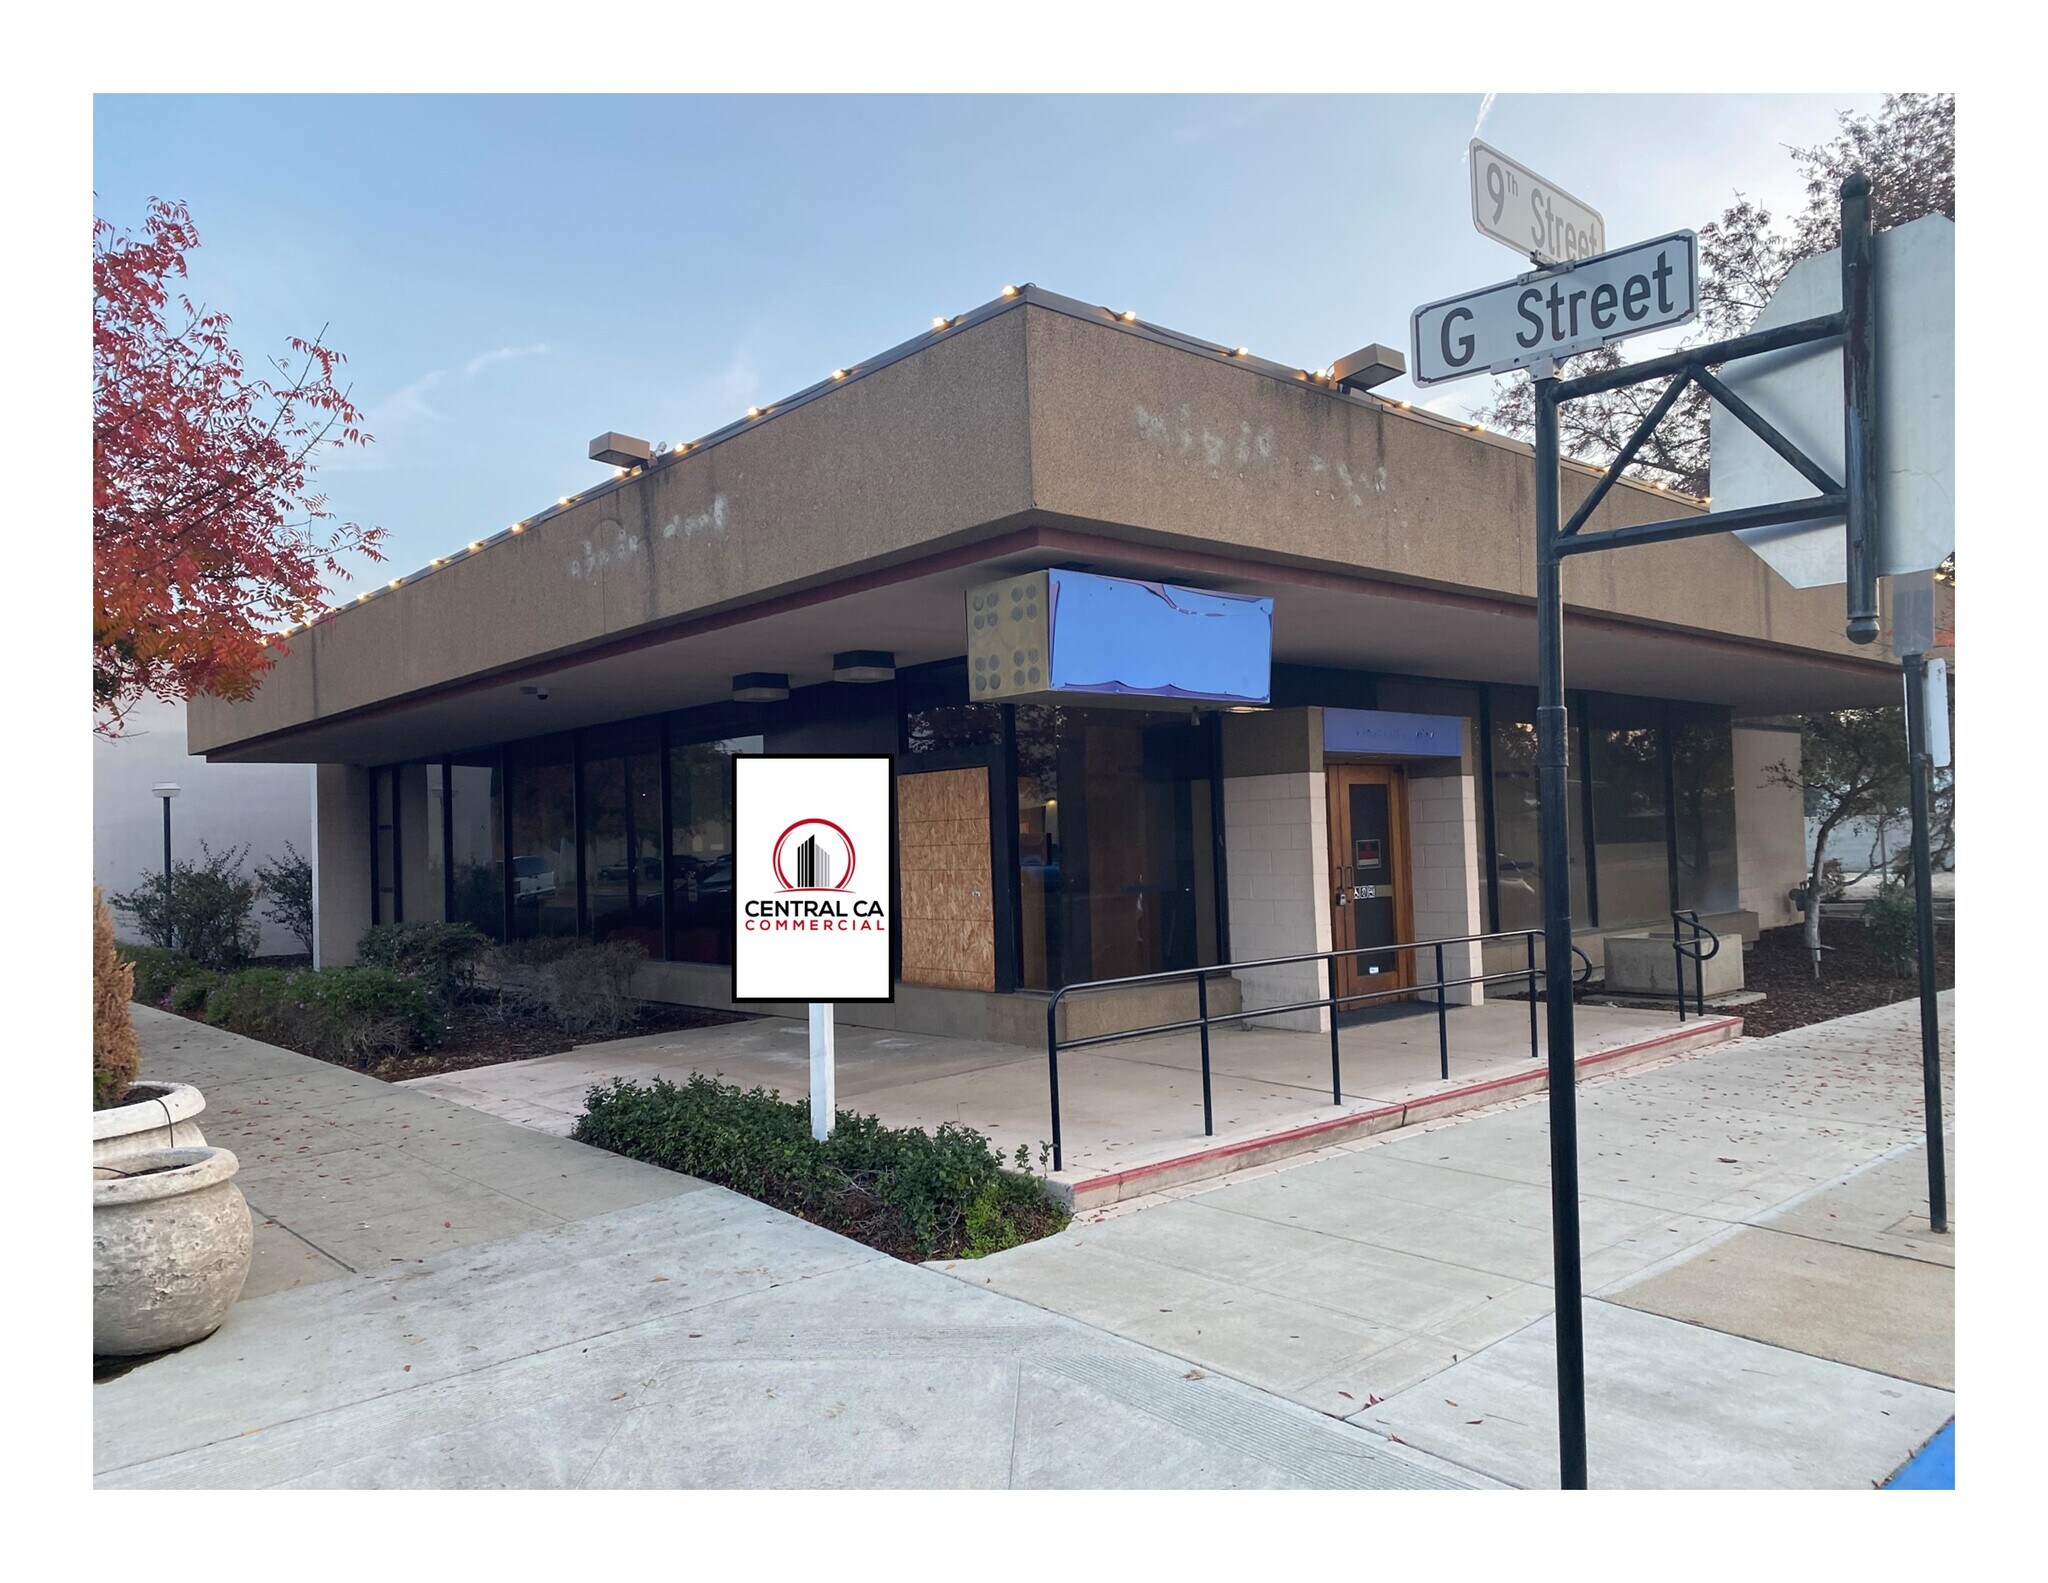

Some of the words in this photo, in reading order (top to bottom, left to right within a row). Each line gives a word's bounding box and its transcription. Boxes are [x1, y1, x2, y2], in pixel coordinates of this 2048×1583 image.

[1531, 188, 1597, 261] Street
[1441, 307, 1475, 367] G
[1516, 250, 1674, 348] Street
